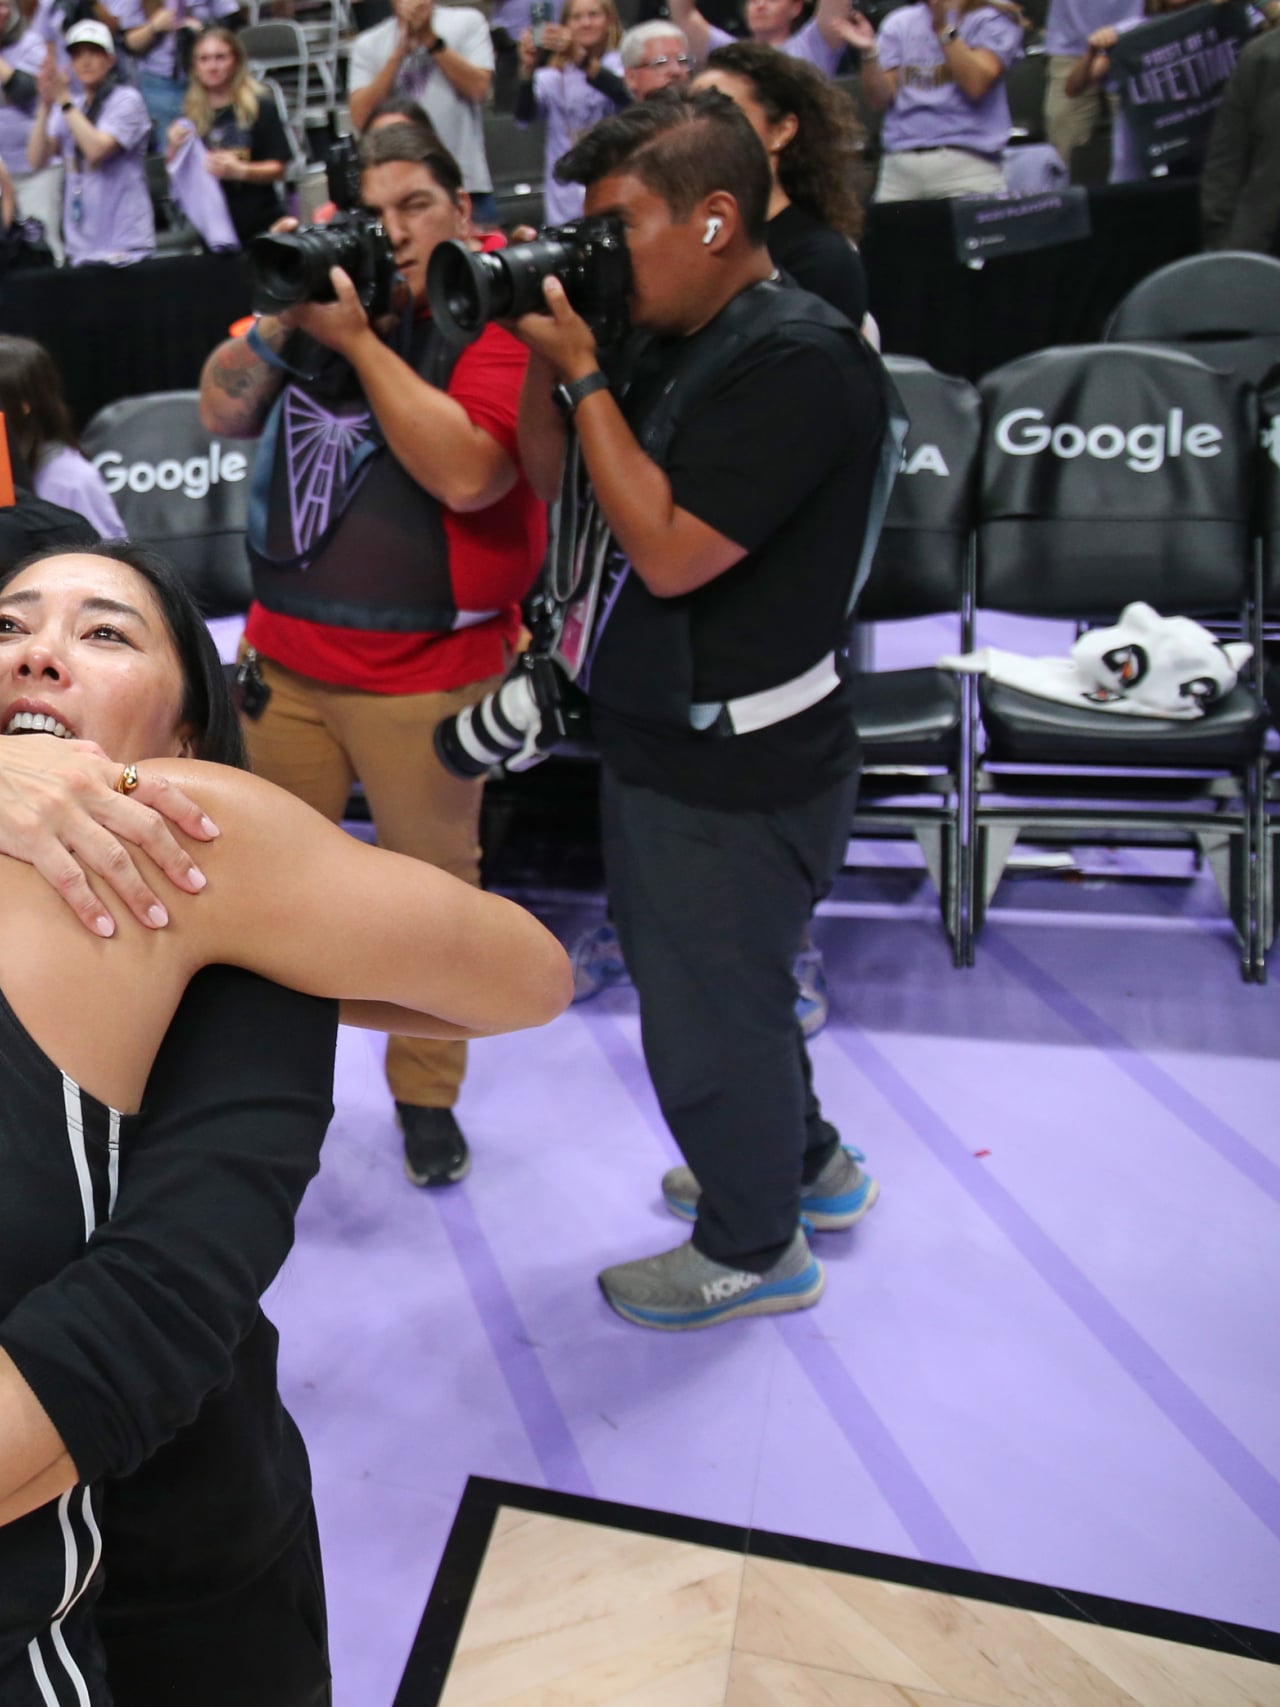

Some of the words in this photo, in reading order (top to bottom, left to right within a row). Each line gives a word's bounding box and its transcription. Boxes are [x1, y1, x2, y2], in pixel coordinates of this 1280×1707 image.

[900, 443, 950, 477] A
[994, 406, 1223, 473] Google
[92, 440, 248, 500] Google
